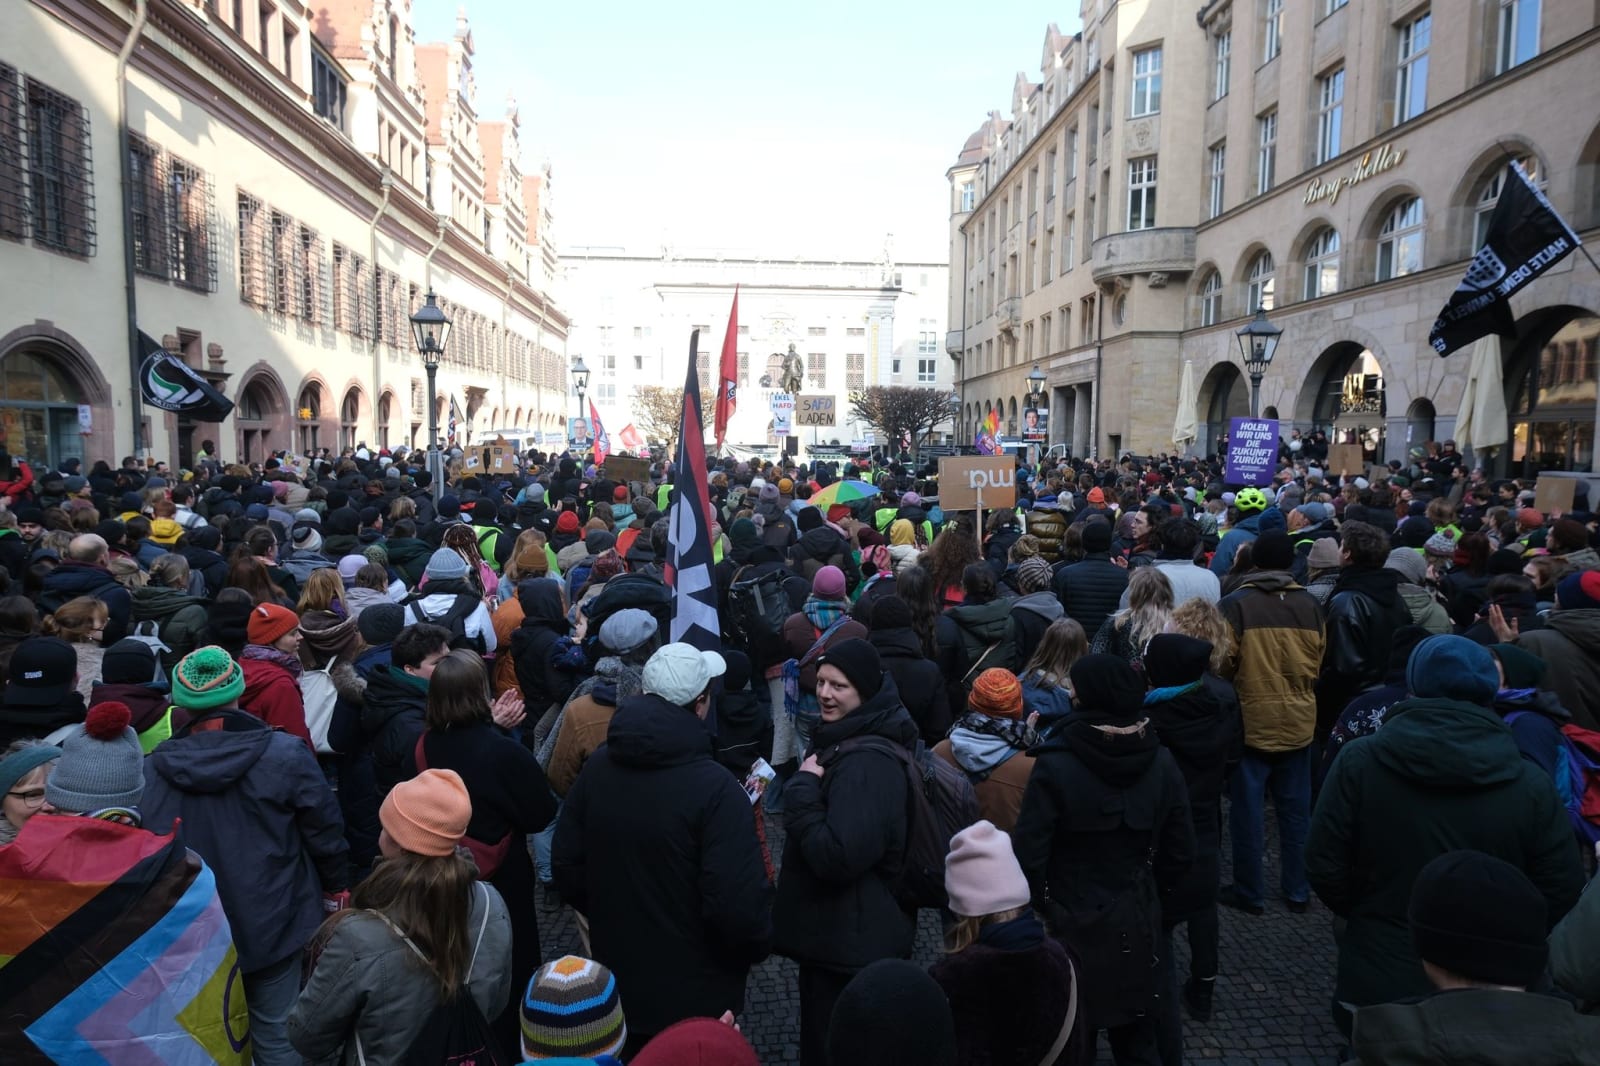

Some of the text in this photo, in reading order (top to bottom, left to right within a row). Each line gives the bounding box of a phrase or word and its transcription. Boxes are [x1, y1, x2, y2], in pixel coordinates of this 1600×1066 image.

[803, 398, 833, 411] SAFD
[798, 412, 834, 425] LADEN
[1240, 422, 1269, 431] HOLEN
[1236, 430, 1272, 440] WIR UNS
[1245, 439, 1261, 447] DIE
[1231, 447, 1274, 457] ZUKUNFT
[1232, 455, 1270, 465] ZURÜCK
